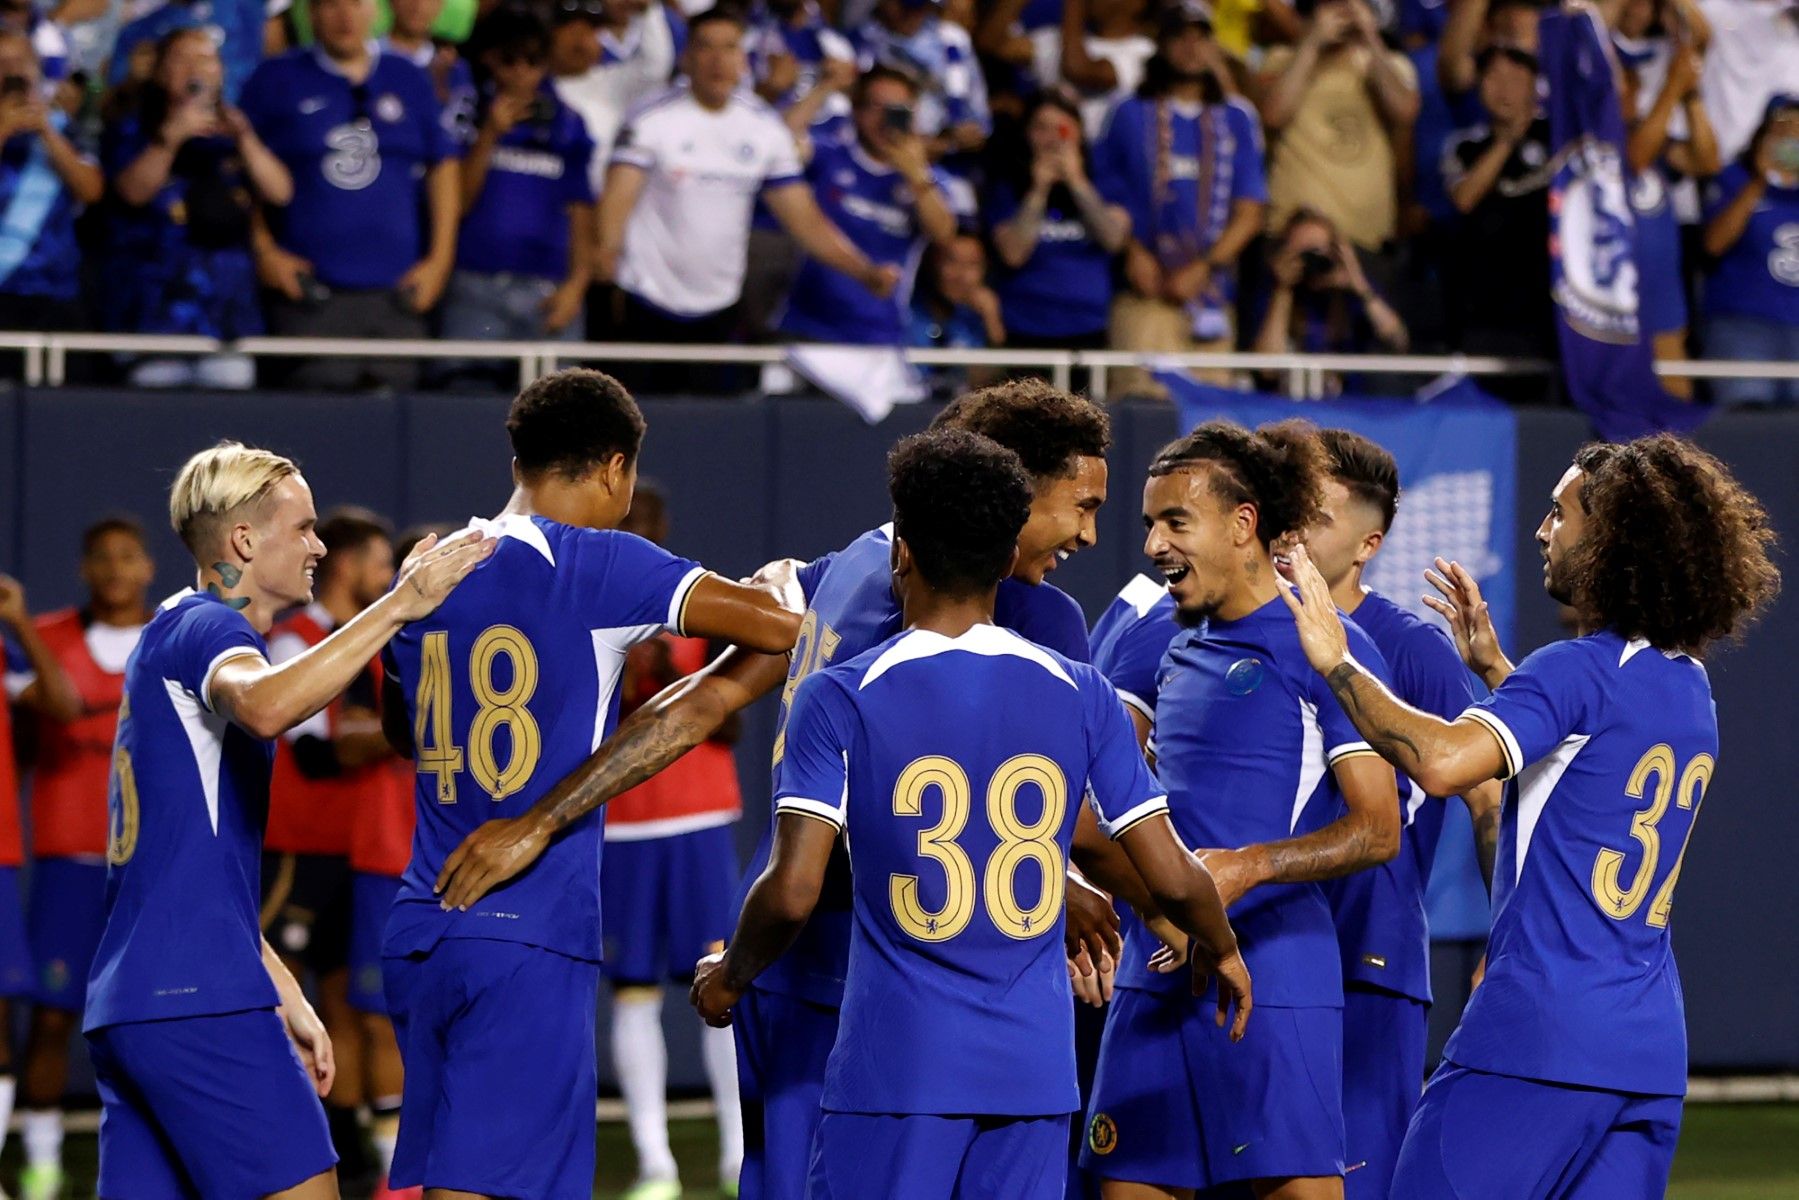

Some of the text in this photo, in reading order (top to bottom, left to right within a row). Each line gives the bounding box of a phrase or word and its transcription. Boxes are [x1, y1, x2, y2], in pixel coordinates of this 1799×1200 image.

[322, 122, 381, 190] 3
[414, 623, 542, 804] 48
[889, 753, 1067, 942] 38
[1591, 743, 1716, 929] 32
